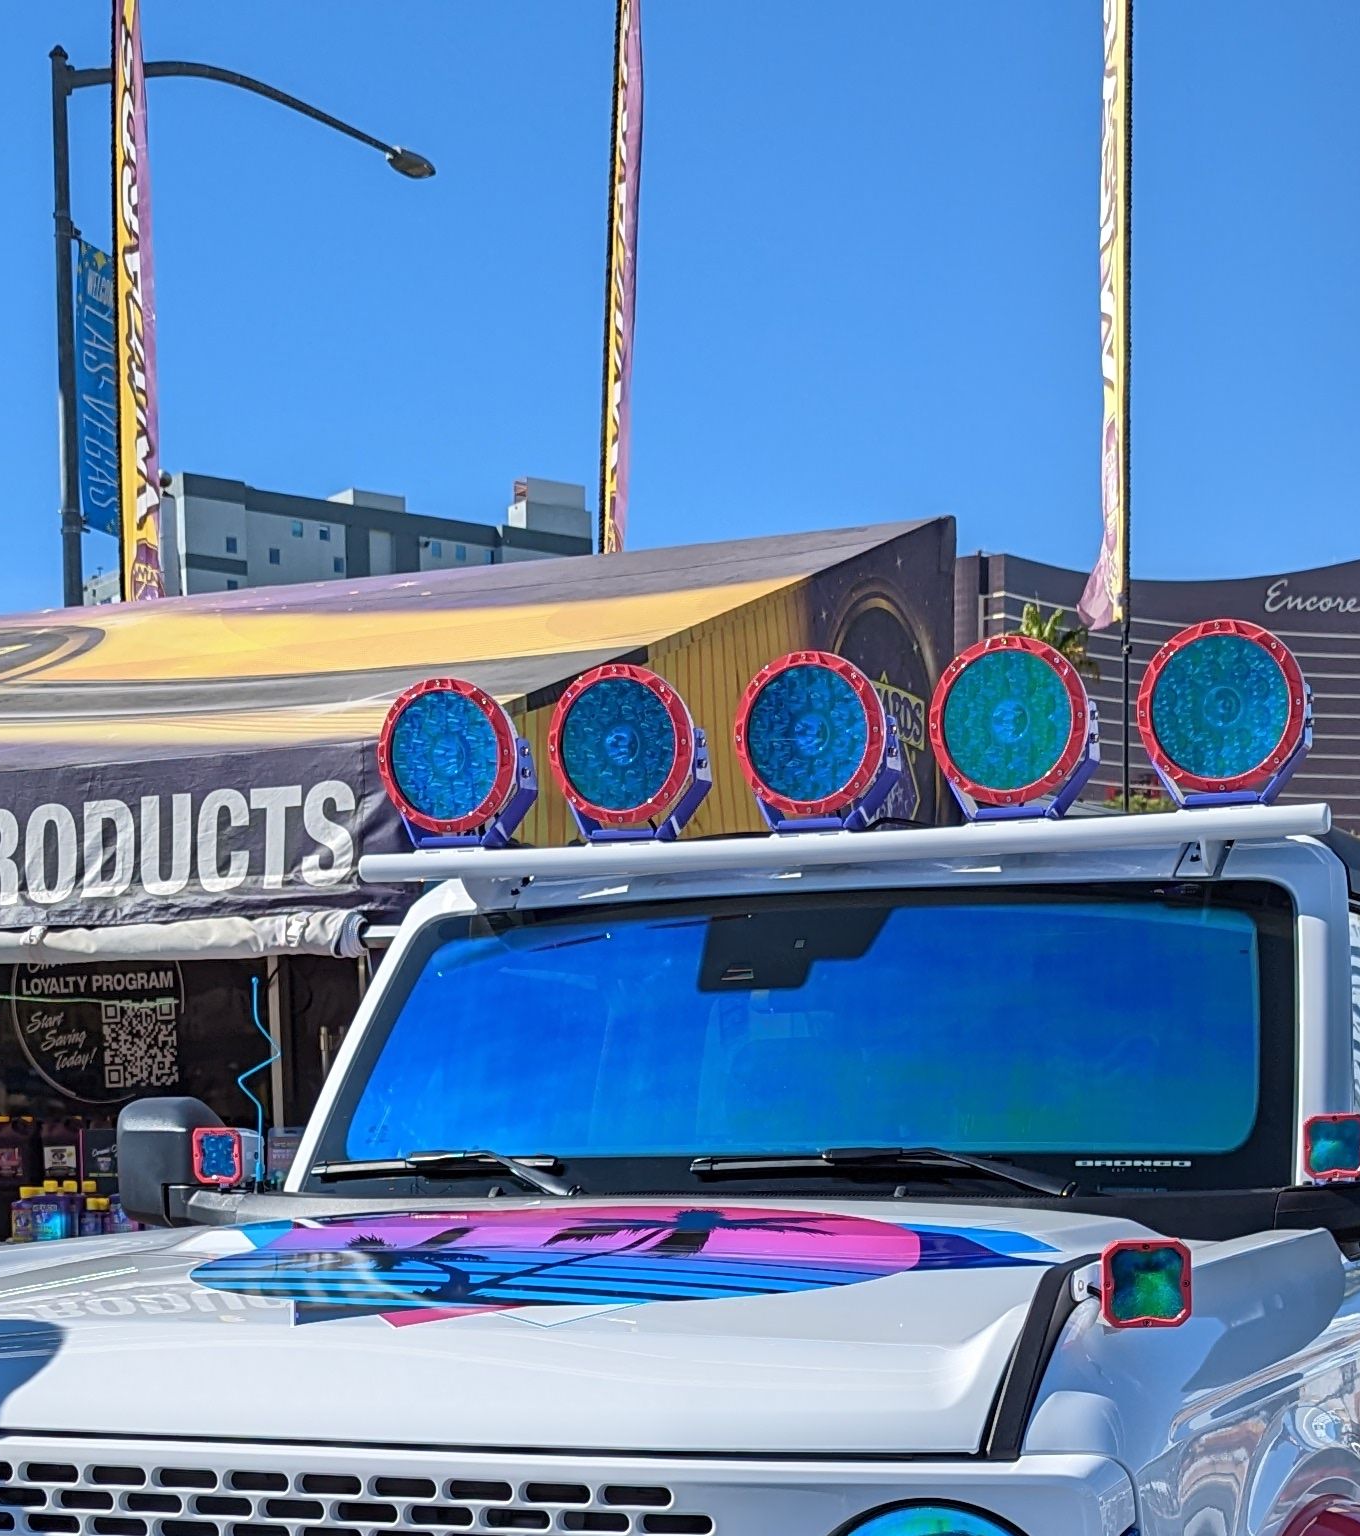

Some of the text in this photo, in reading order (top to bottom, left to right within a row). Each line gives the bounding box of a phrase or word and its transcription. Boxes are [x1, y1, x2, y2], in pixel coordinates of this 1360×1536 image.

[22, 971, 174, 995] LOYALTY PROGRAM
[26, 1011, 65, 1034] Start
[41, 1028, 87, 1051] Saving
[54, 1047, 97, 1071] Today!
